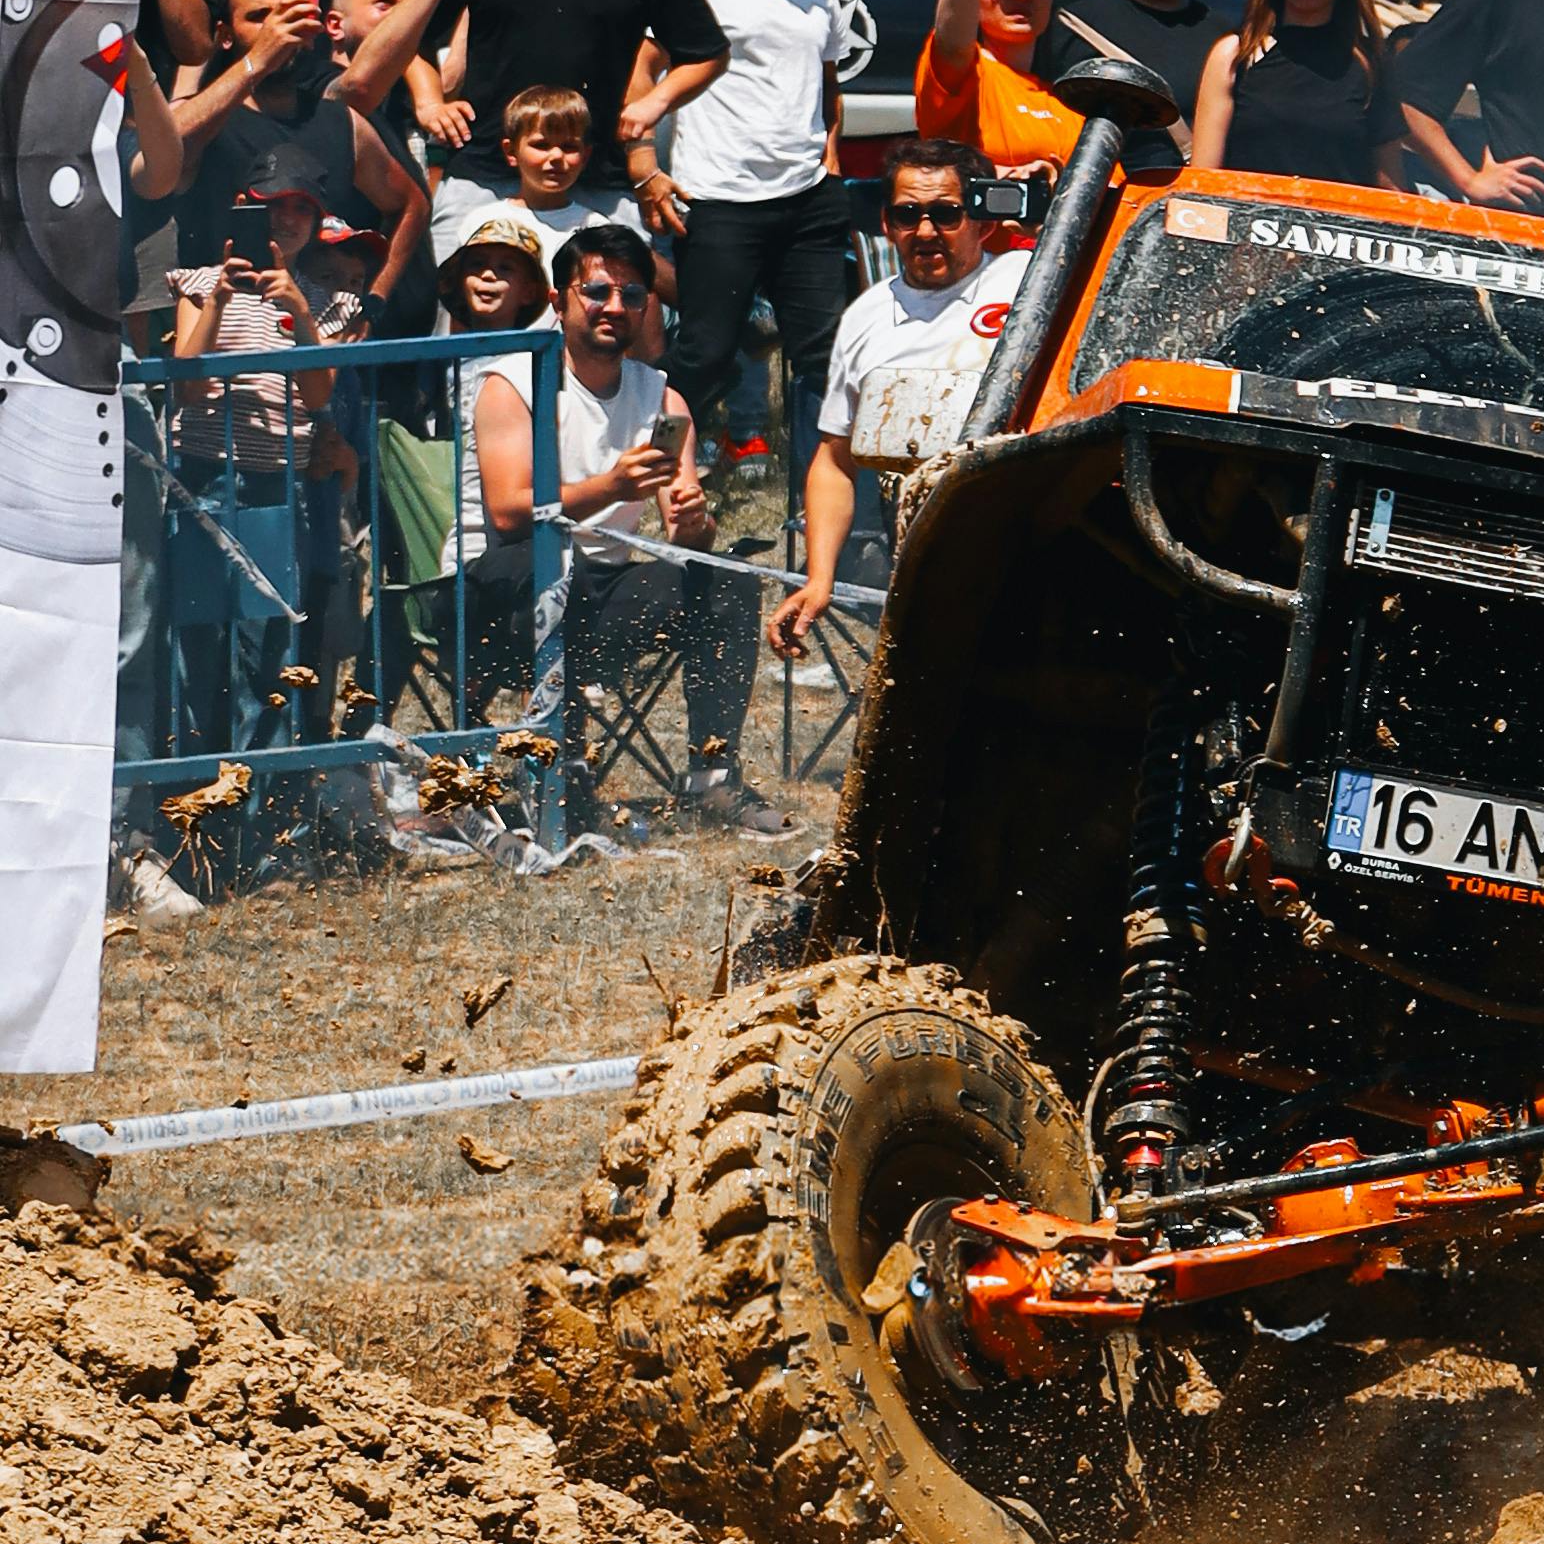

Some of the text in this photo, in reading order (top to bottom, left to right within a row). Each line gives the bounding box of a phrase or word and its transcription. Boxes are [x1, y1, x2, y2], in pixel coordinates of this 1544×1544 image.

[1249, 218, 1479, 283] SAMURAI
[1334, 813, 1363, 838] TR
[1373, 783, 1439, 856] 16
[1360, 857, 1400, 871] BURSA
